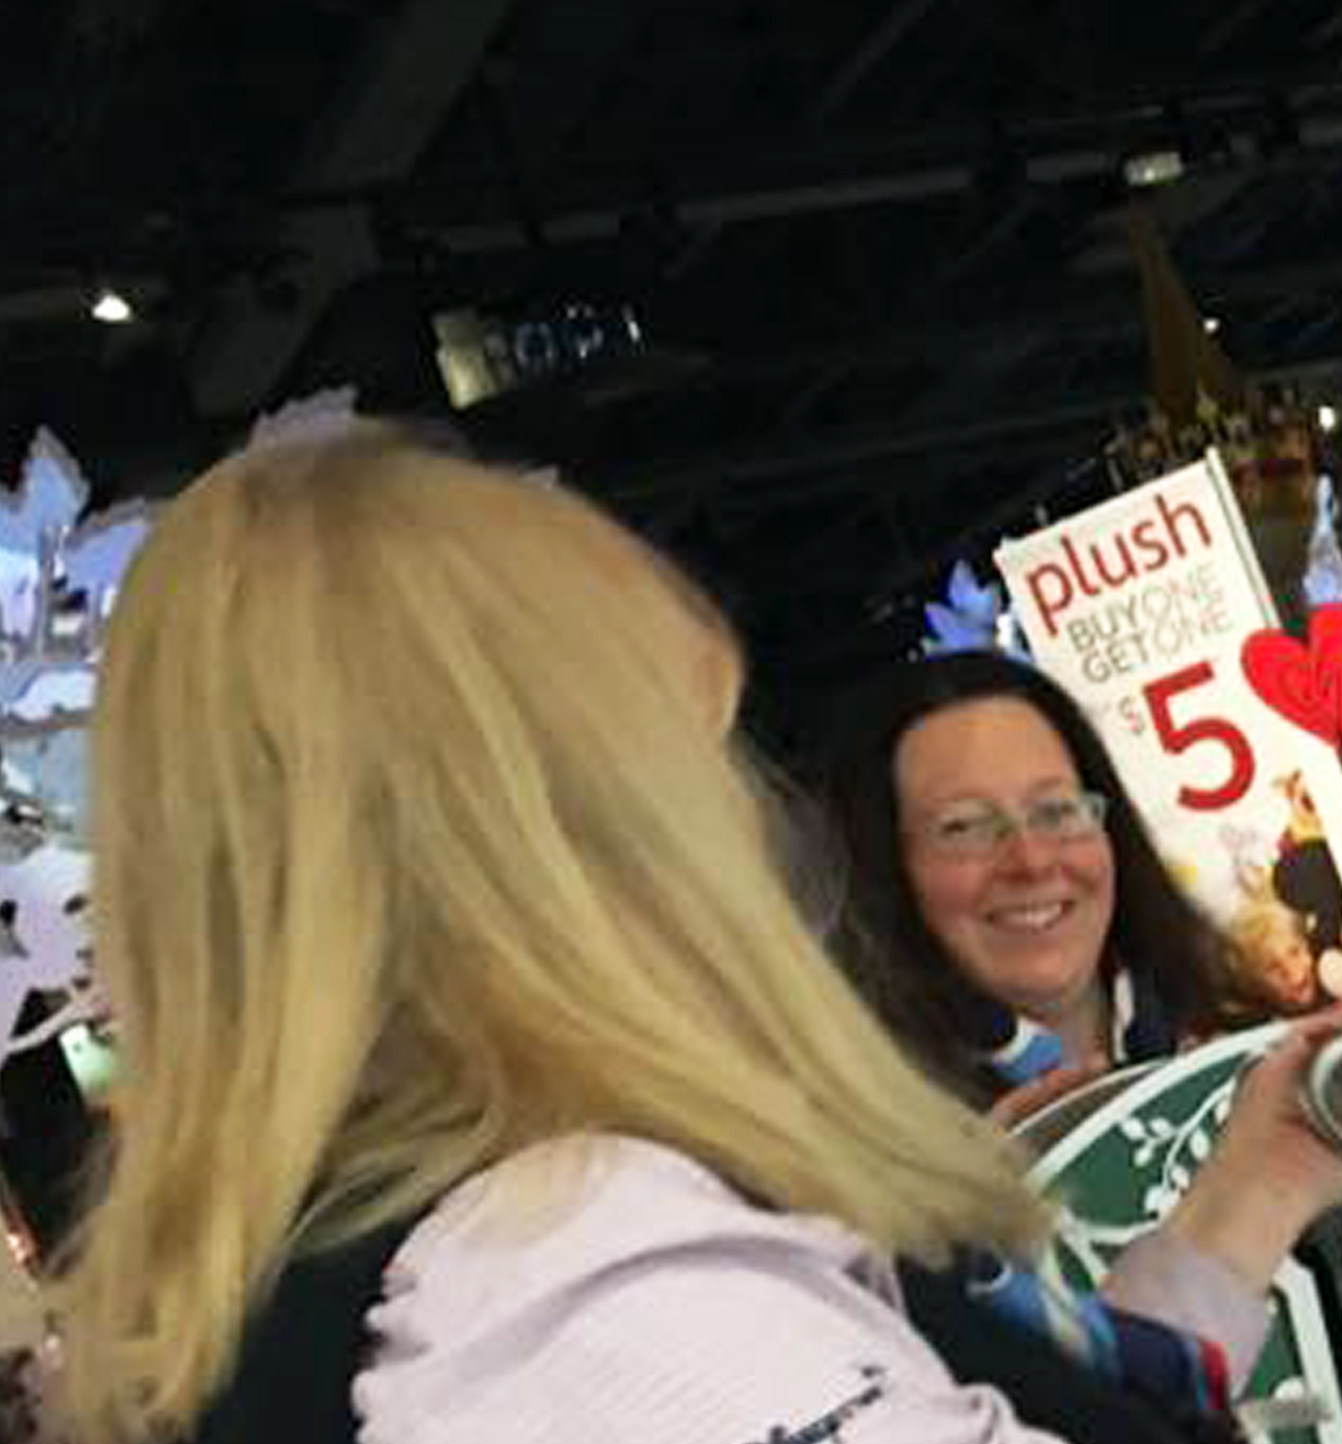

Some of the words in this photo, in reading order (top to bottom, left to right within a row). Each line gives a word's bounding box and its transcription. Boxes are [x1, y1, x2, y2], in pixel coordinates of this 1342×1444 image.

[1025, 494, 1211, 637] plush
[1066, 596, 1139, 654] BUY
[1138, 561, 1225, 622] ONE
[1082, 631, 1150, 685] GET
